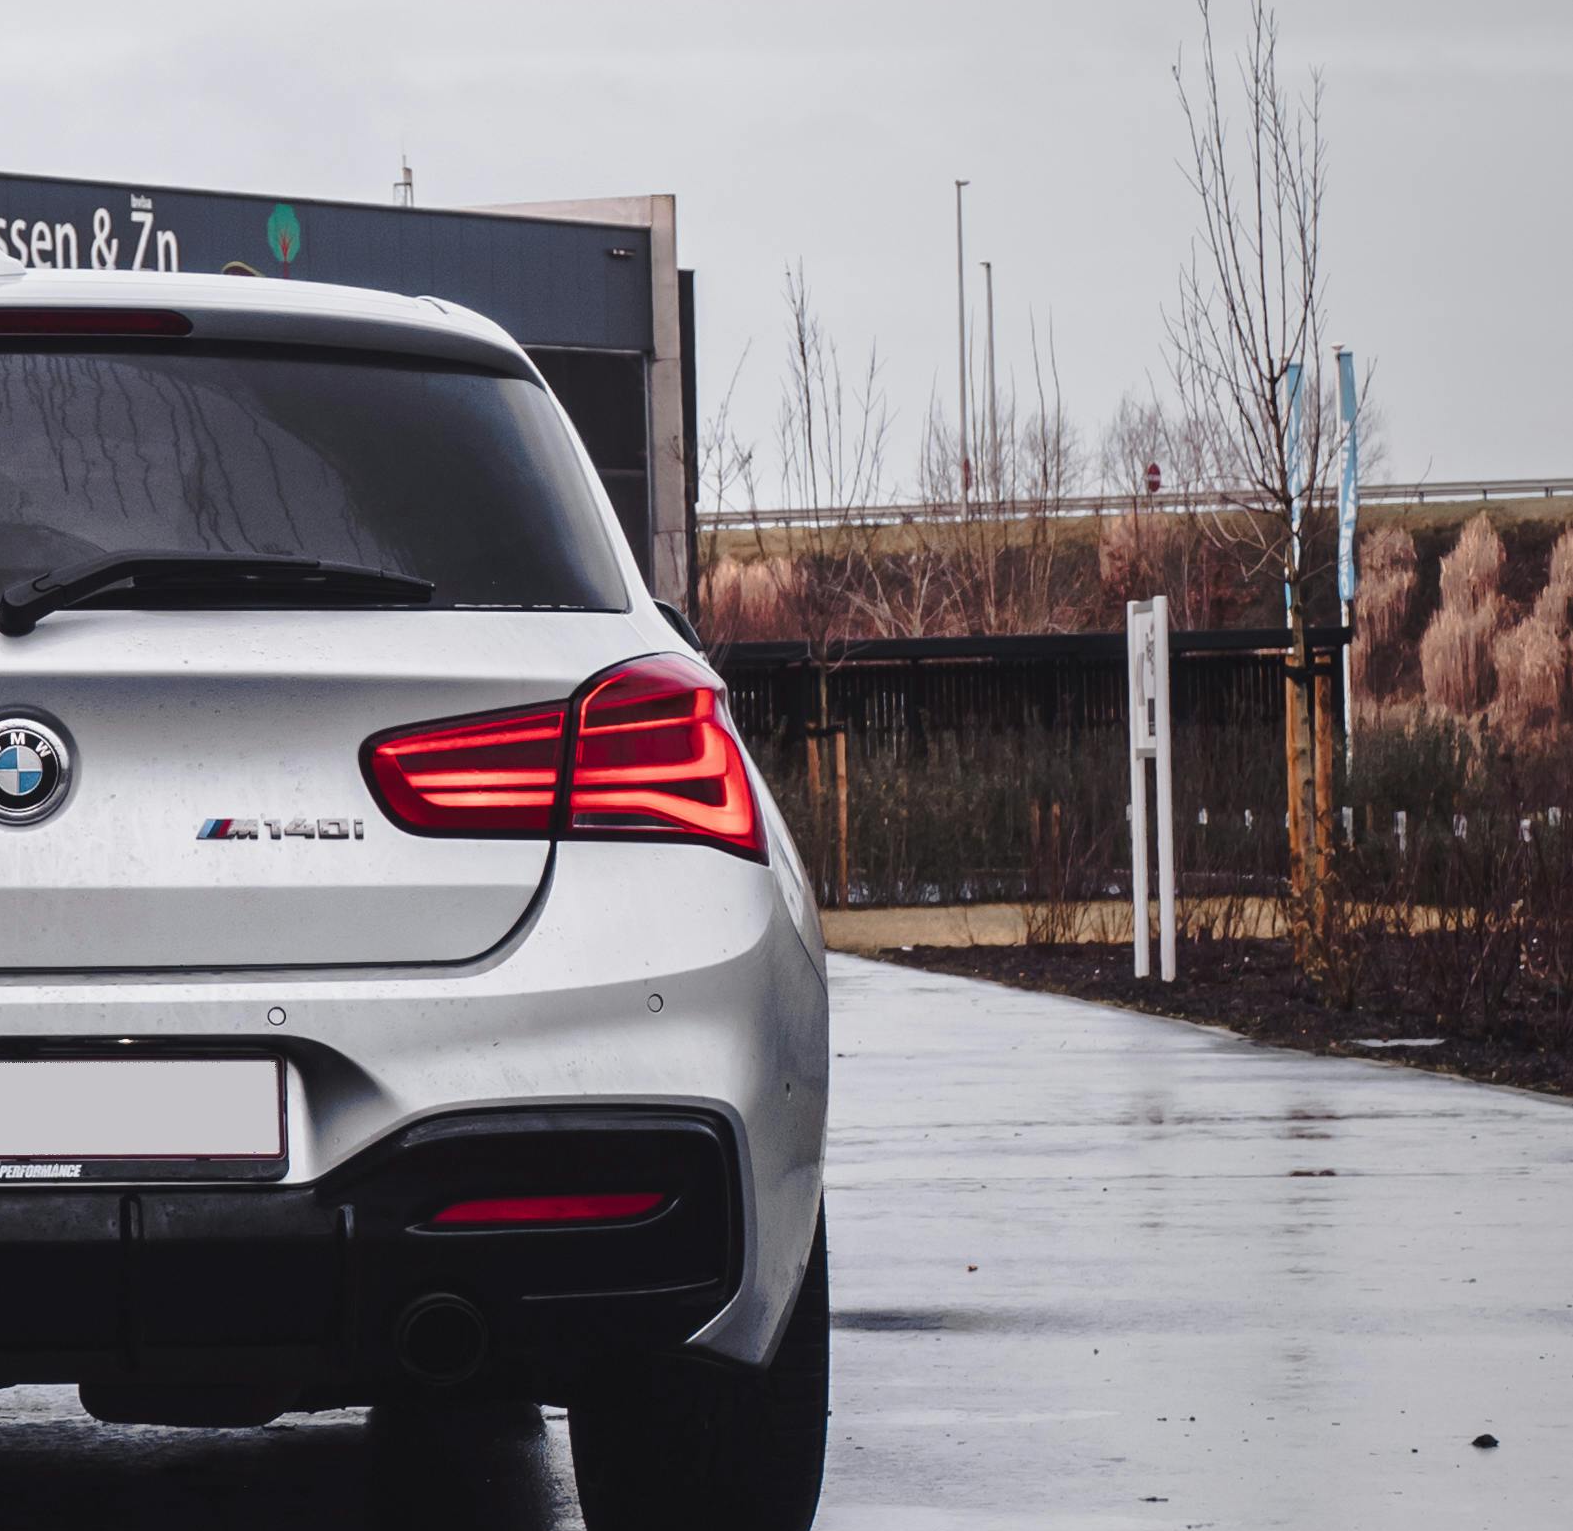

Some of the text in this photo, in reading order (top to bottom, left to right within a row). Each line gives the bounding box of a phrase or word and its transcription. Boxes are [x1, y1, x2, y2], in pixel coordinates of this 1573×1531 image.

[90, 207, 119, 270] &
[130, 211, 179, 273] Zn
[196, 818, 364, 840] M140i
